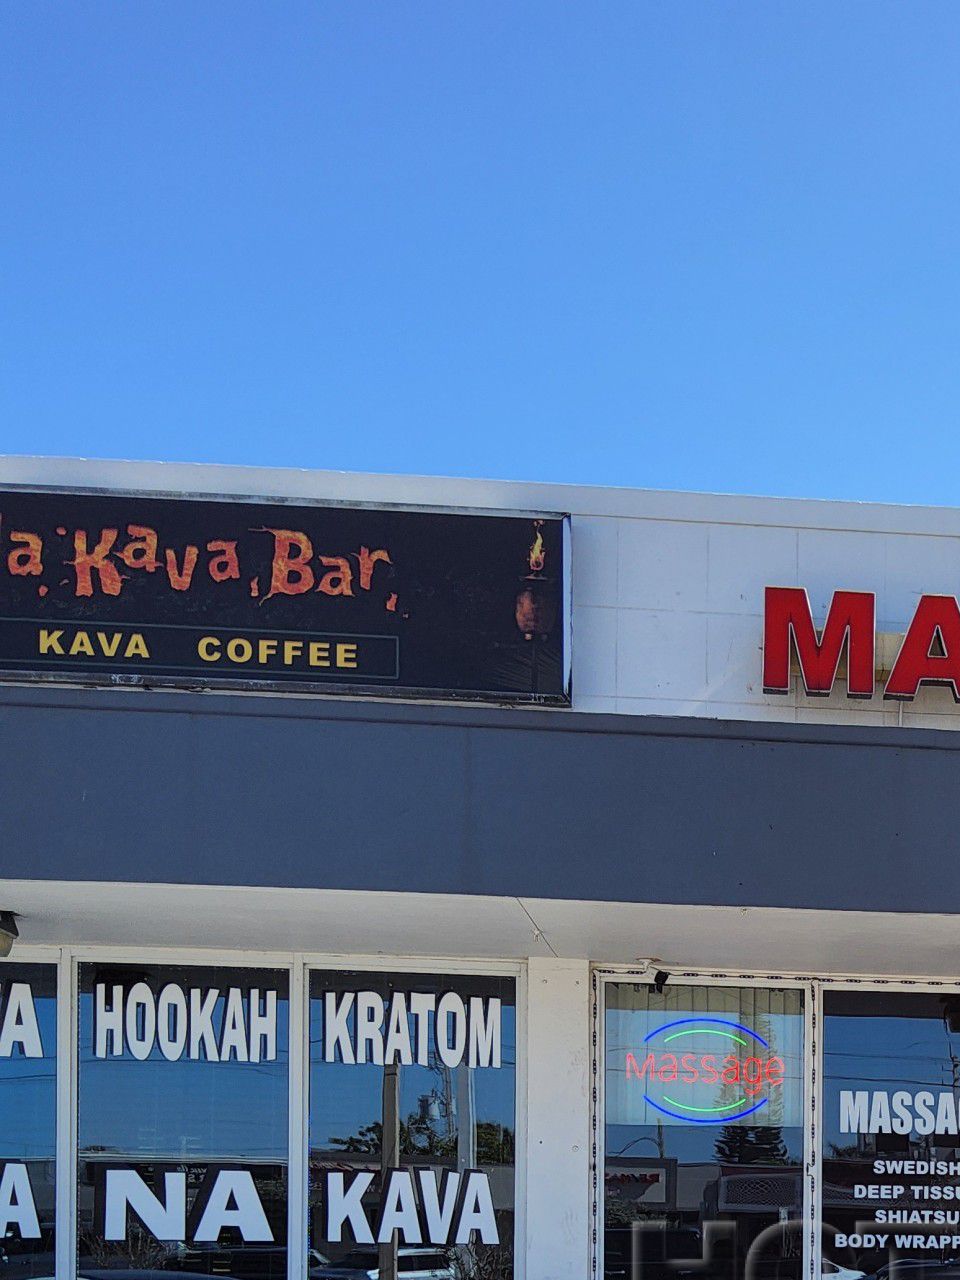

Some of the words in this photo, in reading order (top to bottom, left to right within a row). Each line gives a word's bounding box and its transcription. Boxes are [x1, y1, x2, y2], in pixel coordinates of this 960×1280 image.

[63, 524, 240, 597] Kava
[254, 525, 392, 603] Bar
[38, 629, 150, 659] KAVA
[197, 635, 358, 669] COFFEE
[95, 982, 277, 1063] HOOKAH
[325, 991, 502, 1069] KRATOM
[625, 1052, 786, 1095] Massage
[104, 1170, 274, 1242] NA
[327, 1171, 500, 1245] KAVA
[854, 1185, 904, 1200] DEEP
[875, 1209, 960, 1225] SHIATSU
[835, 1234, 888, 1249] BODY
